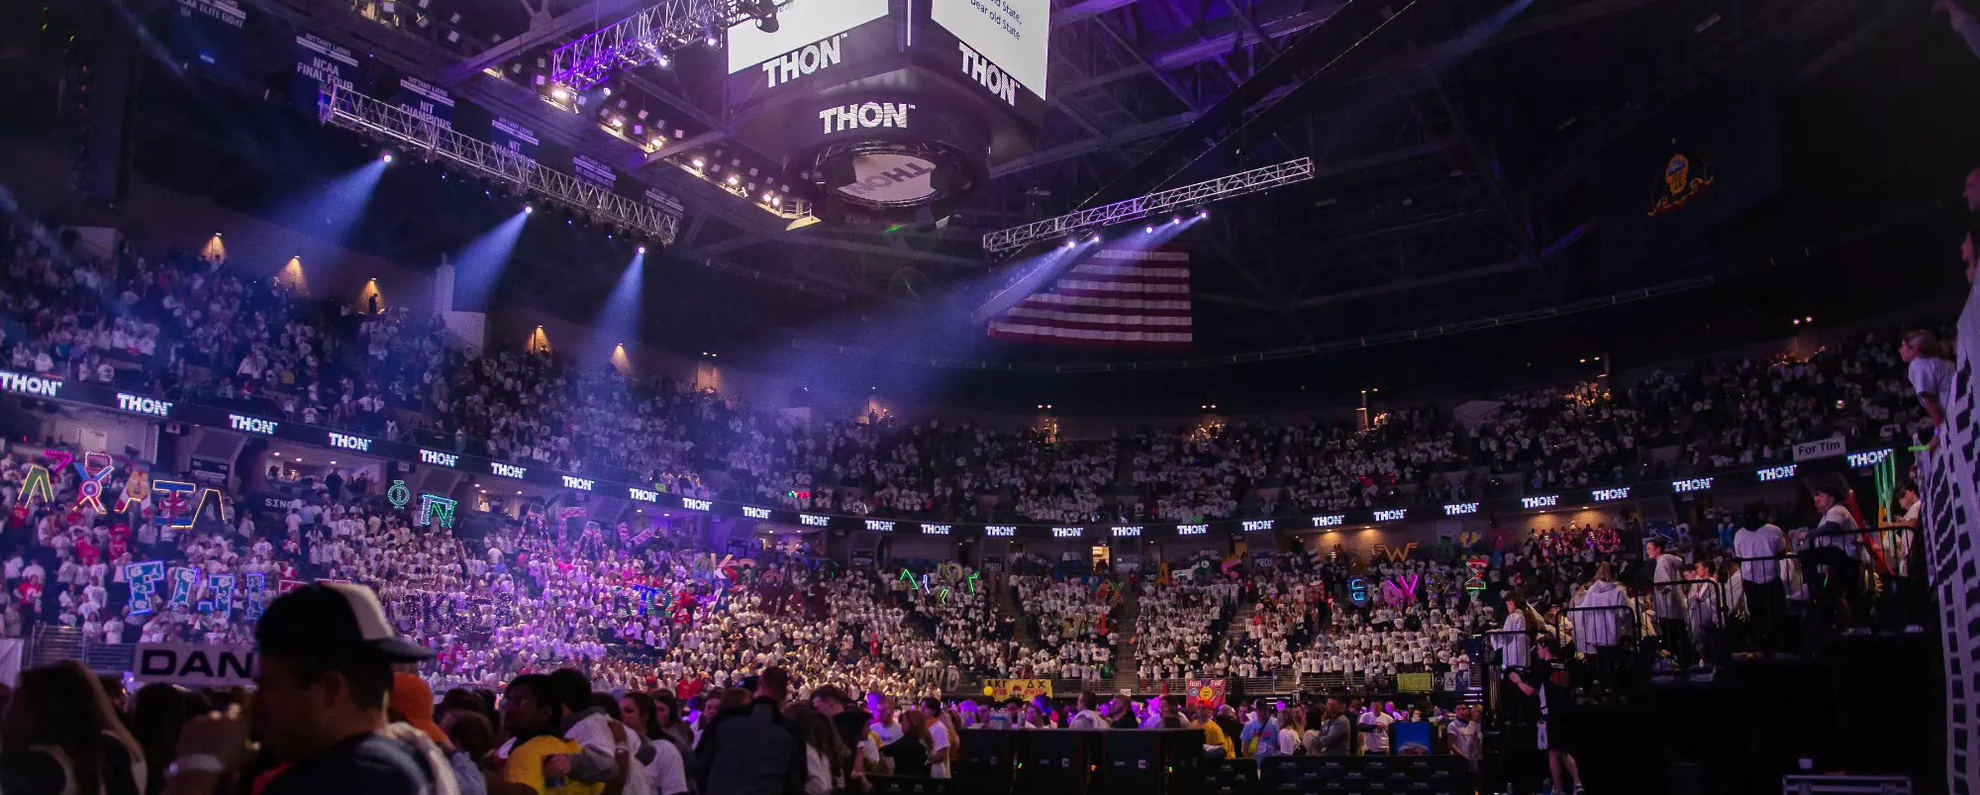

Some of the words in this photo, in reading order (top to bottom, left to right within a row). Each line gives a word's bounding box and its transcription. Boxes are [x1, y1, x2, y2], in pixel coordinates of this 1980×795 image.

[1002, 1, 1022, 25] State,
[989, 11, 1001, 25] old
[1002, 19, 1021, 40] State
[297, 61, 326, 83] FINAL
[313, 56, 339, 76] NCAA
[420, 100, 435, 114] NIT
[1797, 445, 1817, 456] For
[1820, 440, 1840, 452] Tim
